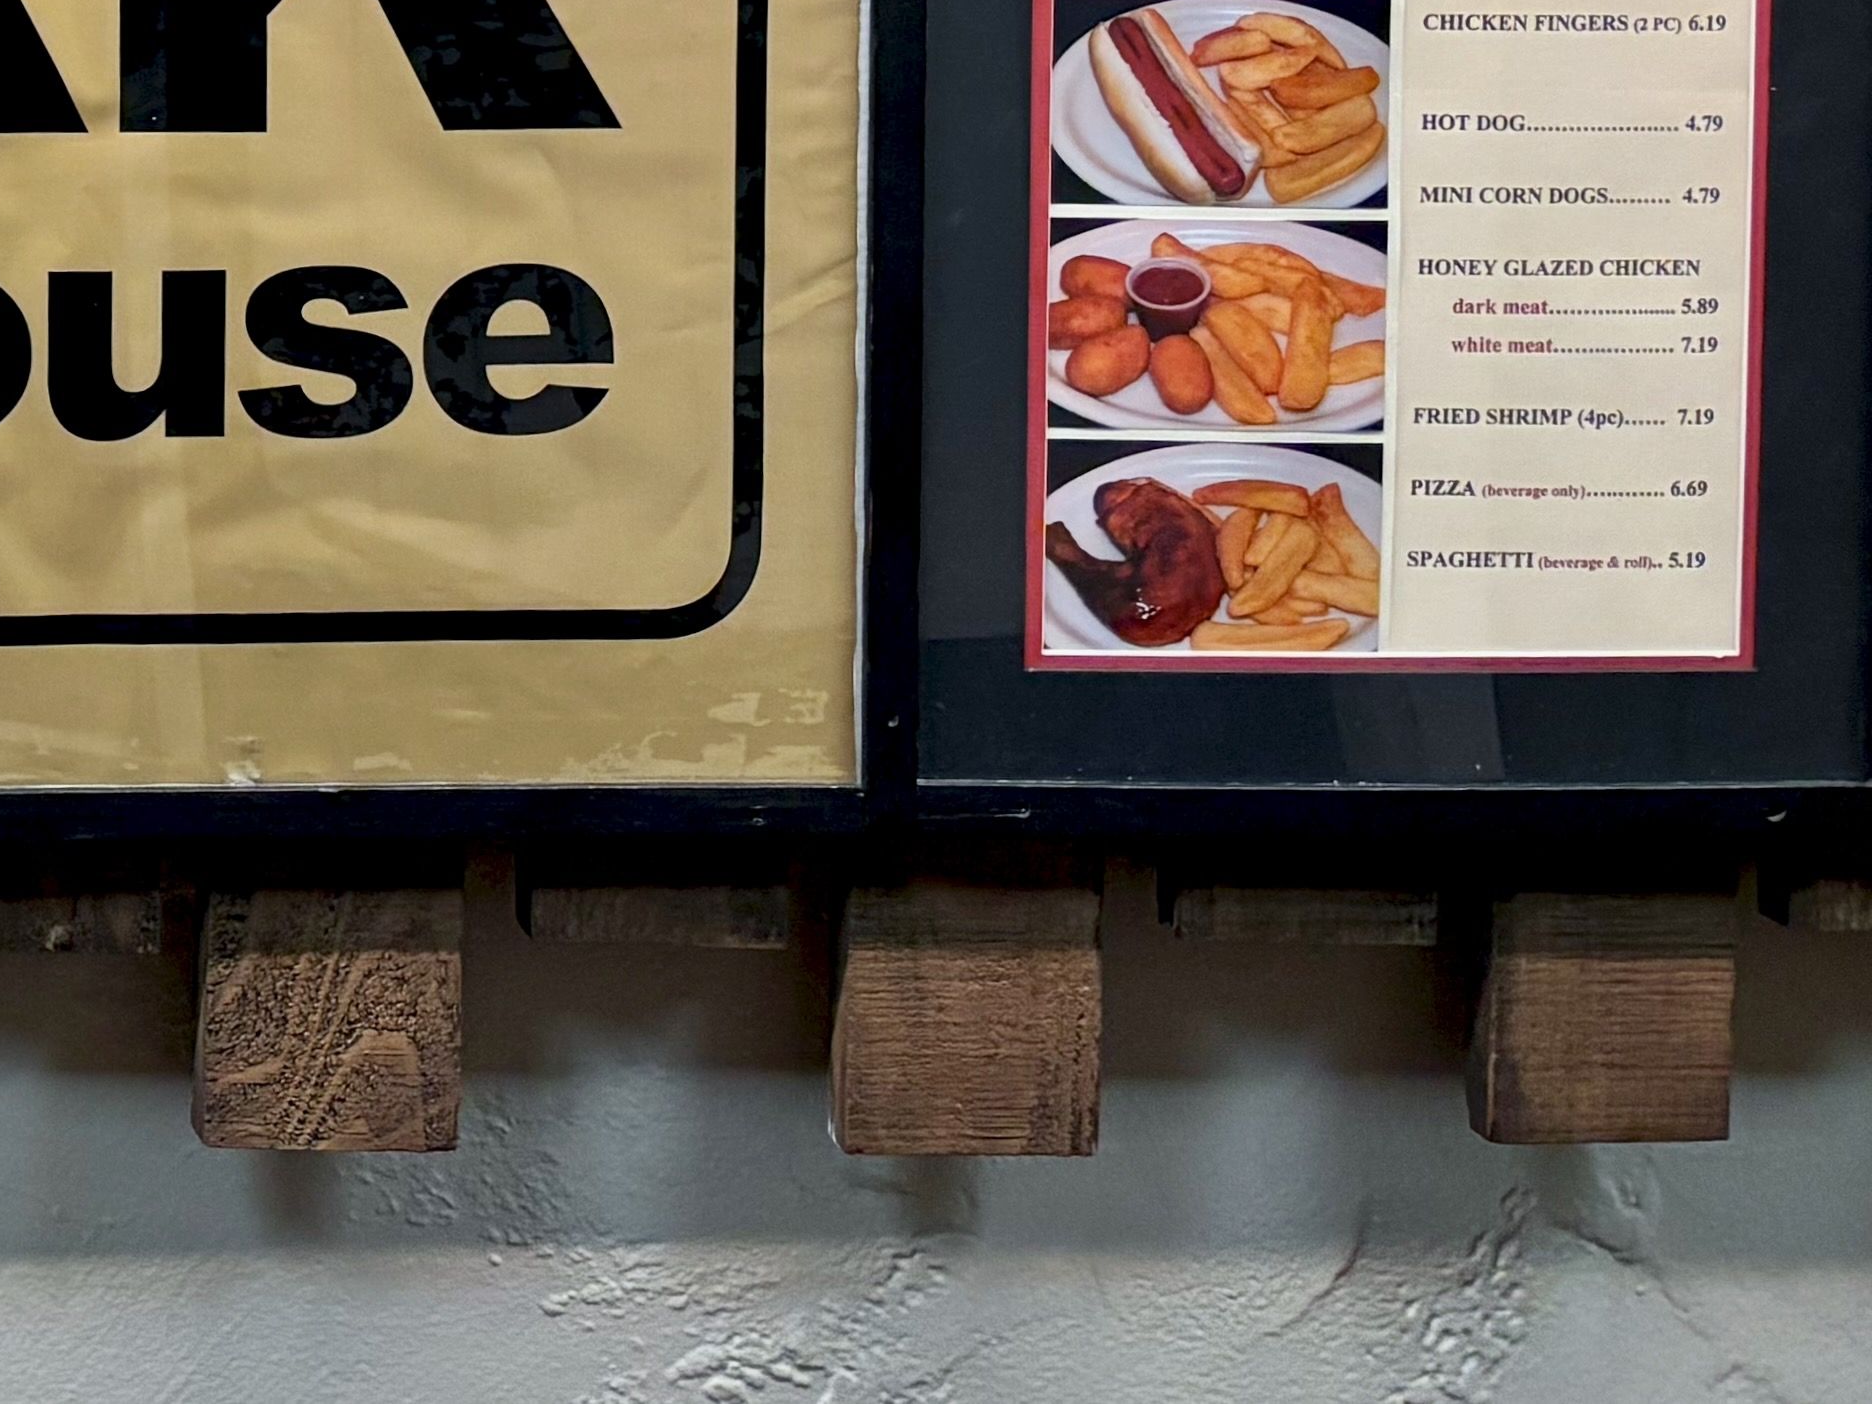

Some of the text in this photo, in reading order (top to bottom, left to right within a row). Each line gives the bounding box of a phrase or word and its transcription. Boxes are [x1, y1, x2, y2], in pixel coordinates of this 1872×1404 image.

[1422, 13, 1727, 32] CHICKEN FINGERS 6.19
[1421, 113, 1724, 133] HOT 4.79
[1419, 186, 1721, 205] MINI CORN 4.79
[1418, 258, 1701, 277] HONEY GLAZED CHICKEN
[1452, 297, 1719, 315] dark 5.89
[1451, 336, 1719, 354] white 7.19
[1413, 407, 1715, 426] FRIED SHRIMP 7.19
[1410, 479, 1709, 497] PIZZA 6.69
[1406, 550, 1706, 569] SPAGHETTI 5.19
